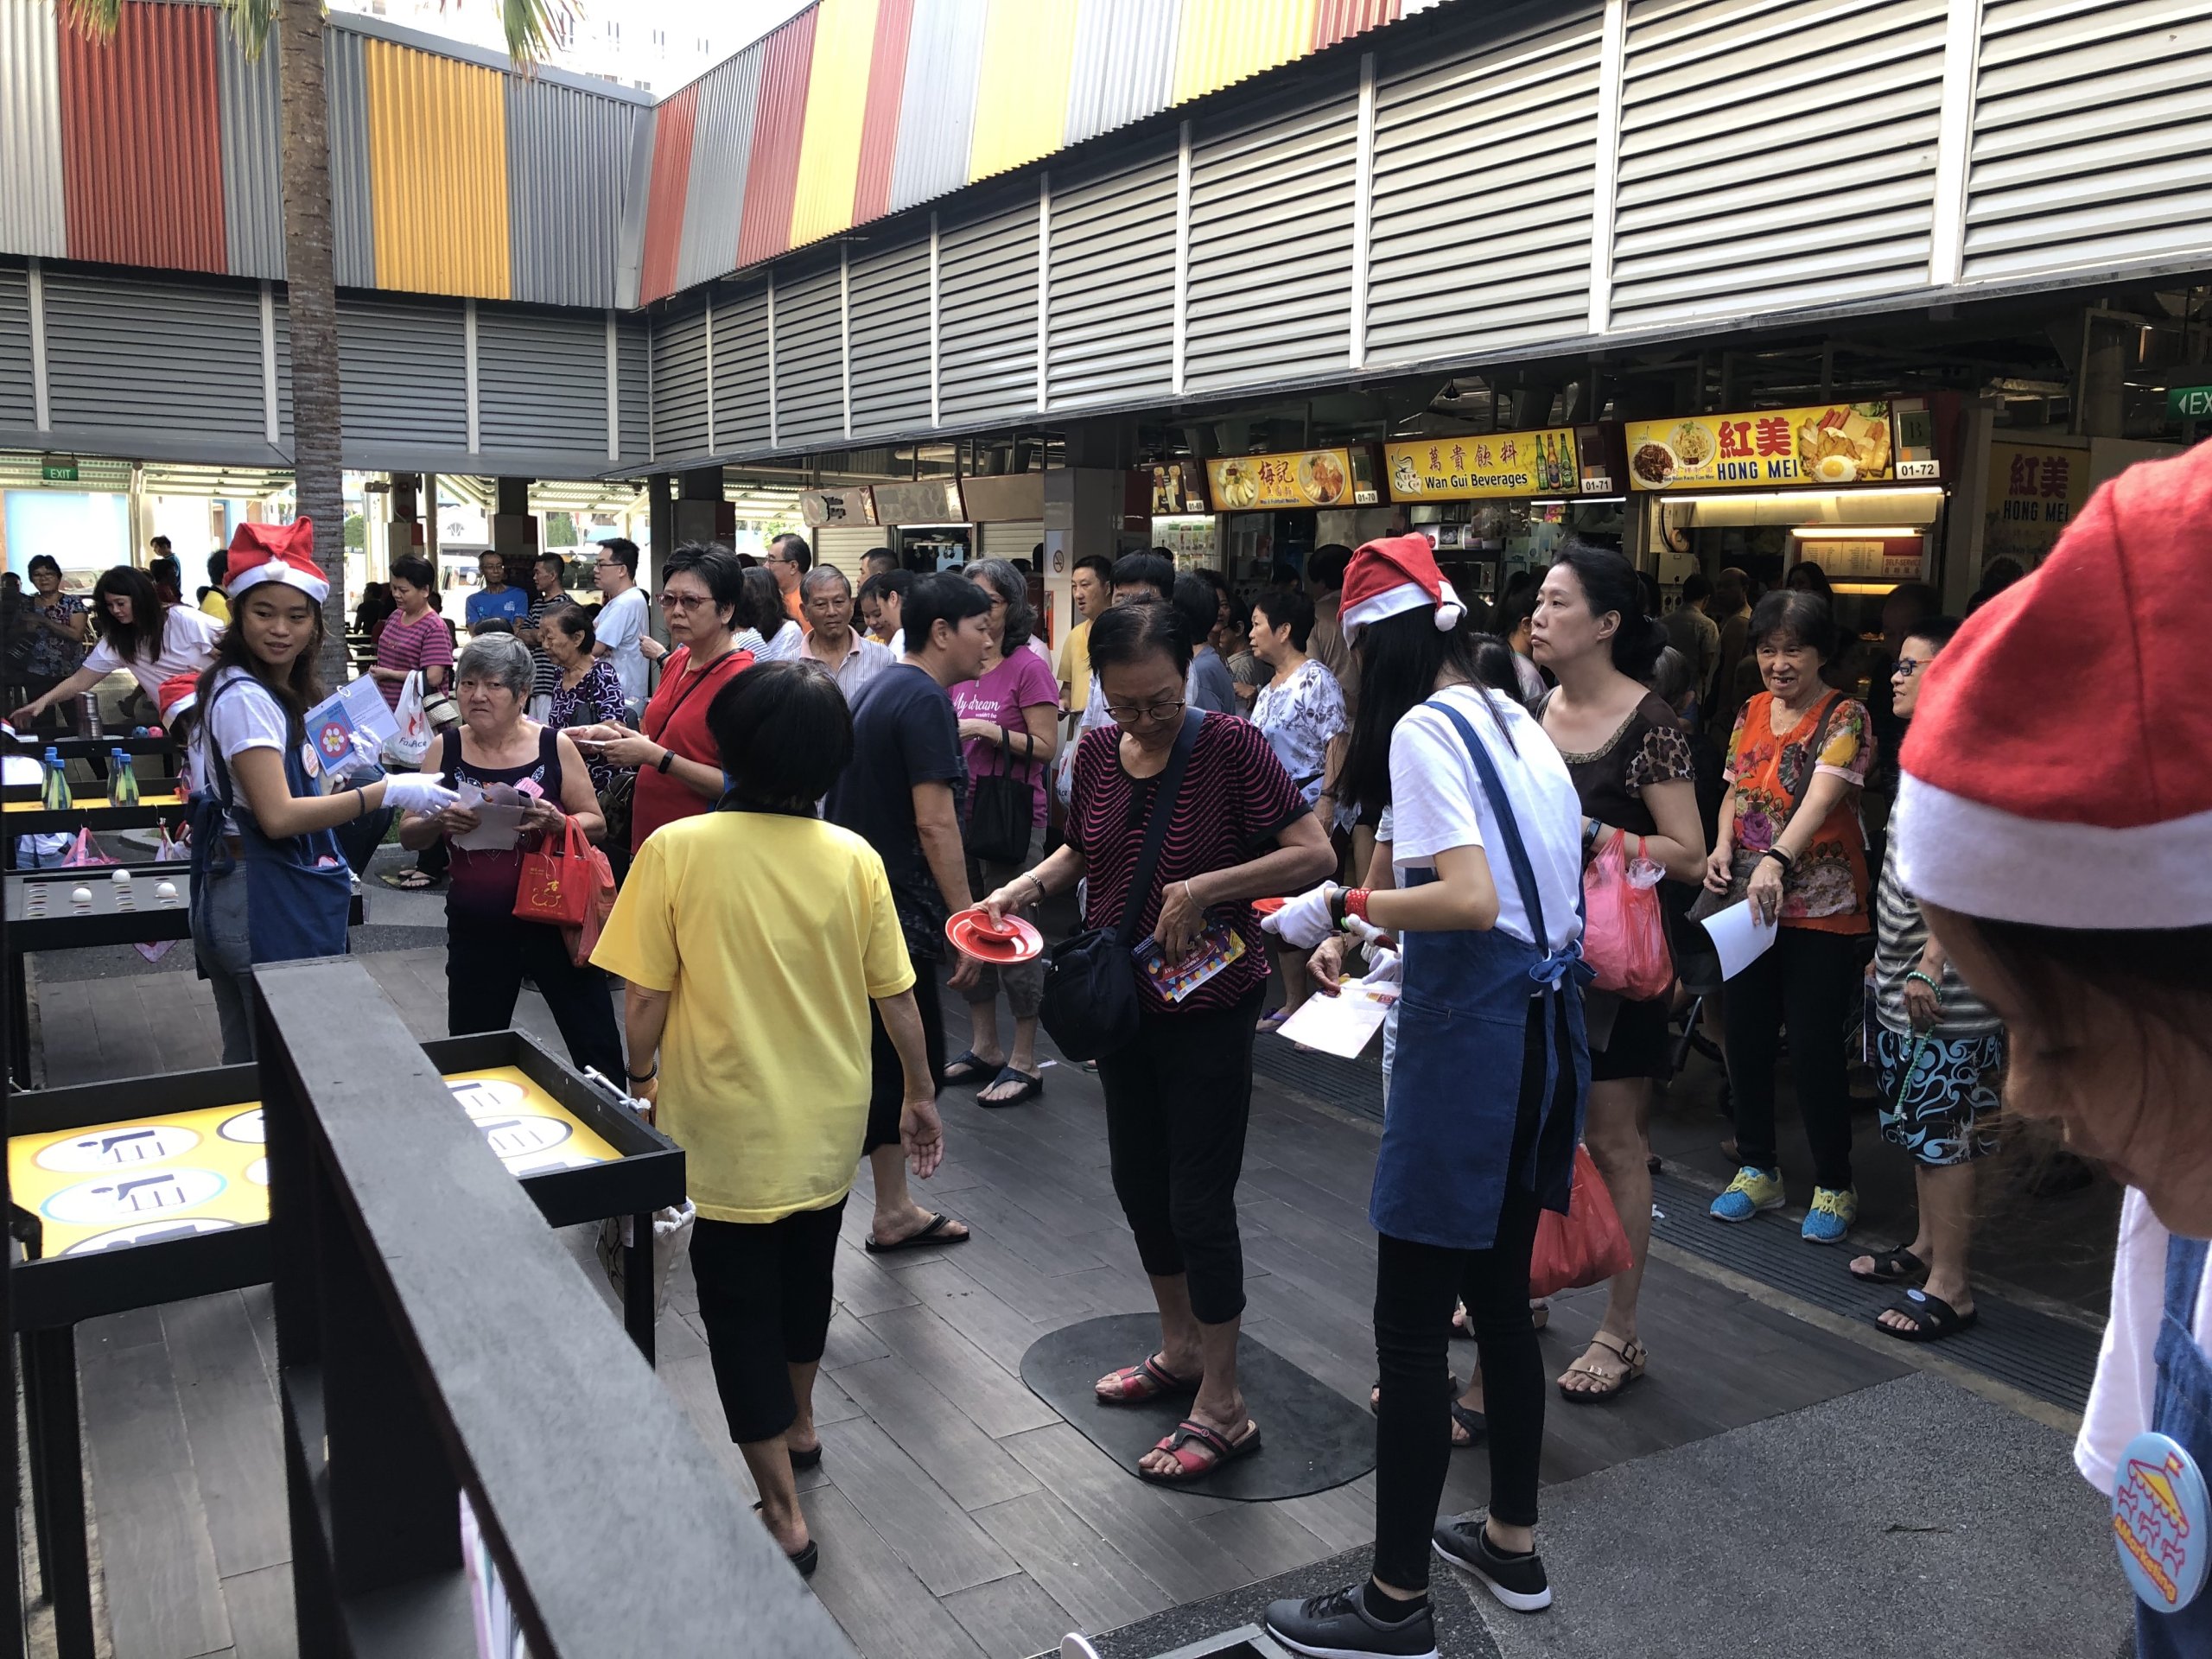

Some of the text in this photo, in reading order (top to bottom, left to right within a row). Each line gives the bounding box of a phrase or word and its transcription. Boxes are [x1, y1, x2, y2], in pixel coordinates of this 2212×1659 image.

[1719, 417, 1792, 459] 紅美
[1428, 439, 1519, 472] 萬貴飲料
[50, 468, 71, 479] EXIT
[1717, 461, 1758, 480] HONG
[1768, 459, 1798, 478] MEI
[1902, 464, 1935, 476] 01-72
[2009, 454, 2069, 499] 紅美
[1425, 472, 1528, 490] Wan Gui Beverages
[1586, 480, 1609, 491] 01-71
[1357, 493, 1376, 502] 01-70
[2004, 500, 2069, 522] HONG MEI
[968, 694, 1000, 712] dream
